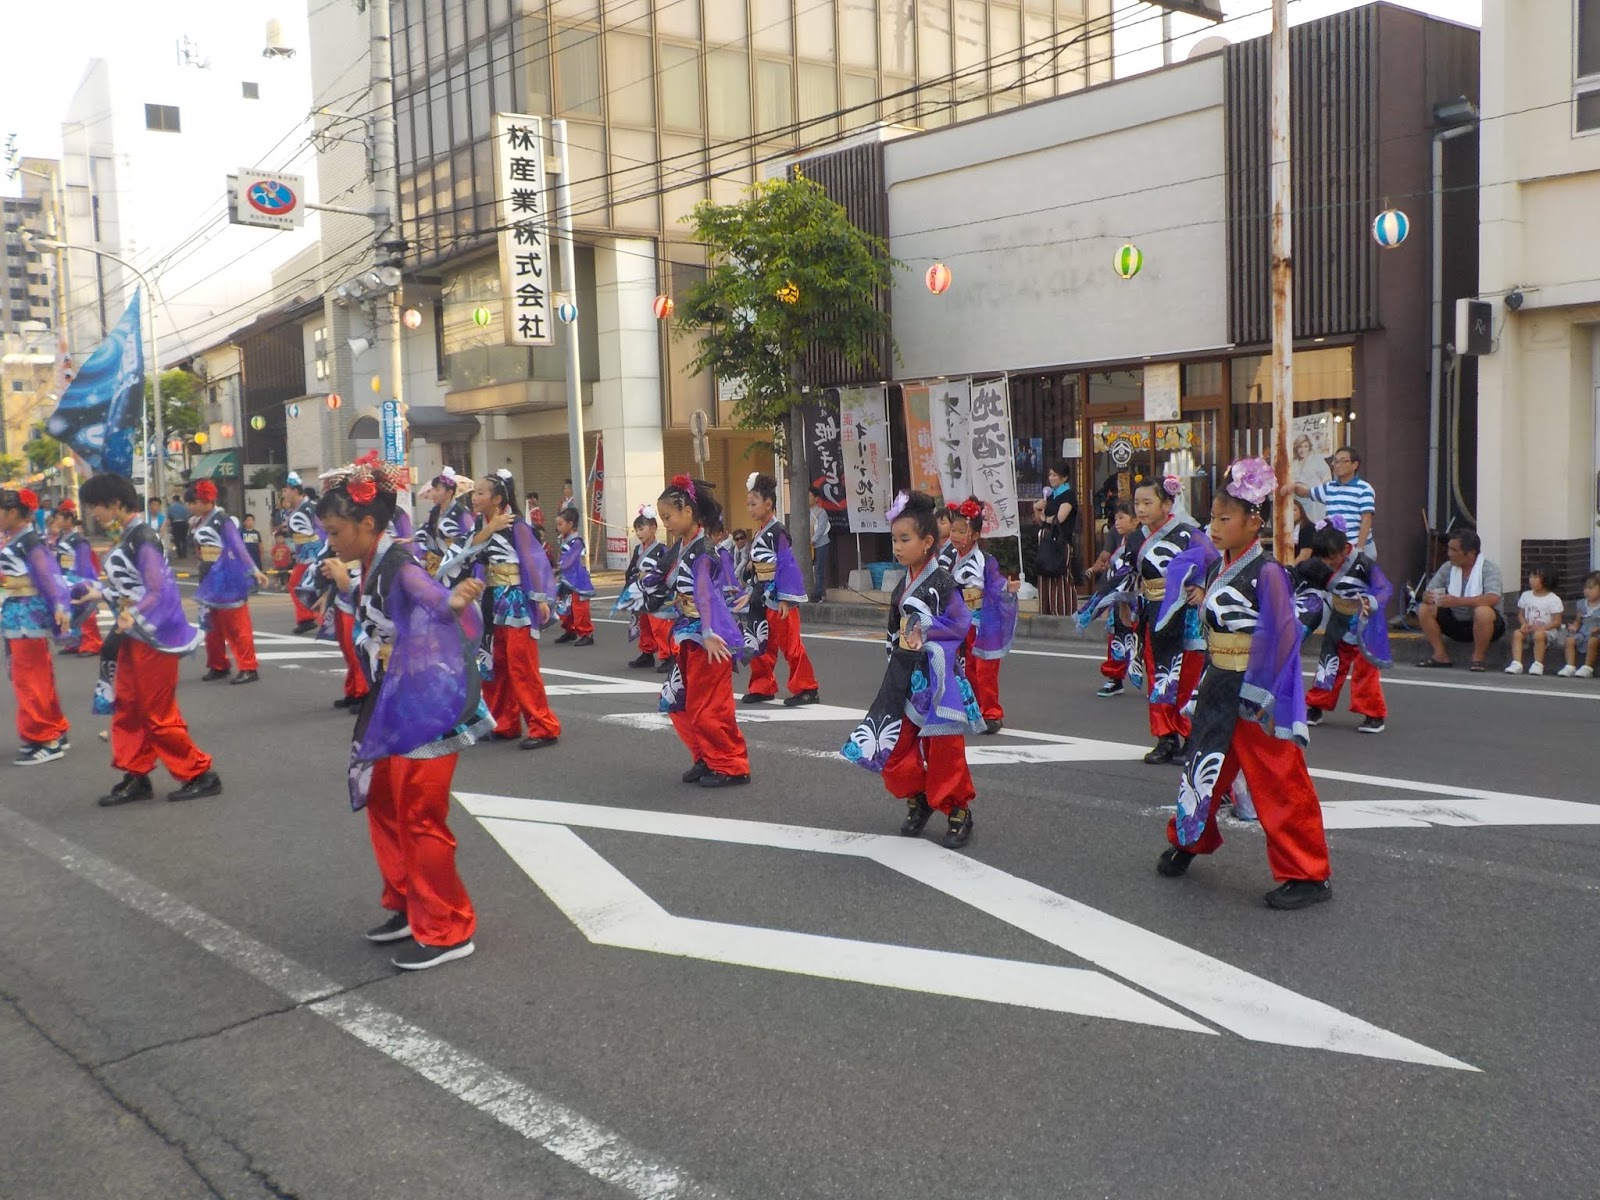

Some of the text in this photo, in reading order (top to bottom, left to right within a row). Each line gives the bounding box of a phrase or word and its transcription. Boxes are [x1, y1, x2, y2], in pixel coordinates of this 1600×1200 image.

[507, 124, 546, 339] 林産業株式会社
